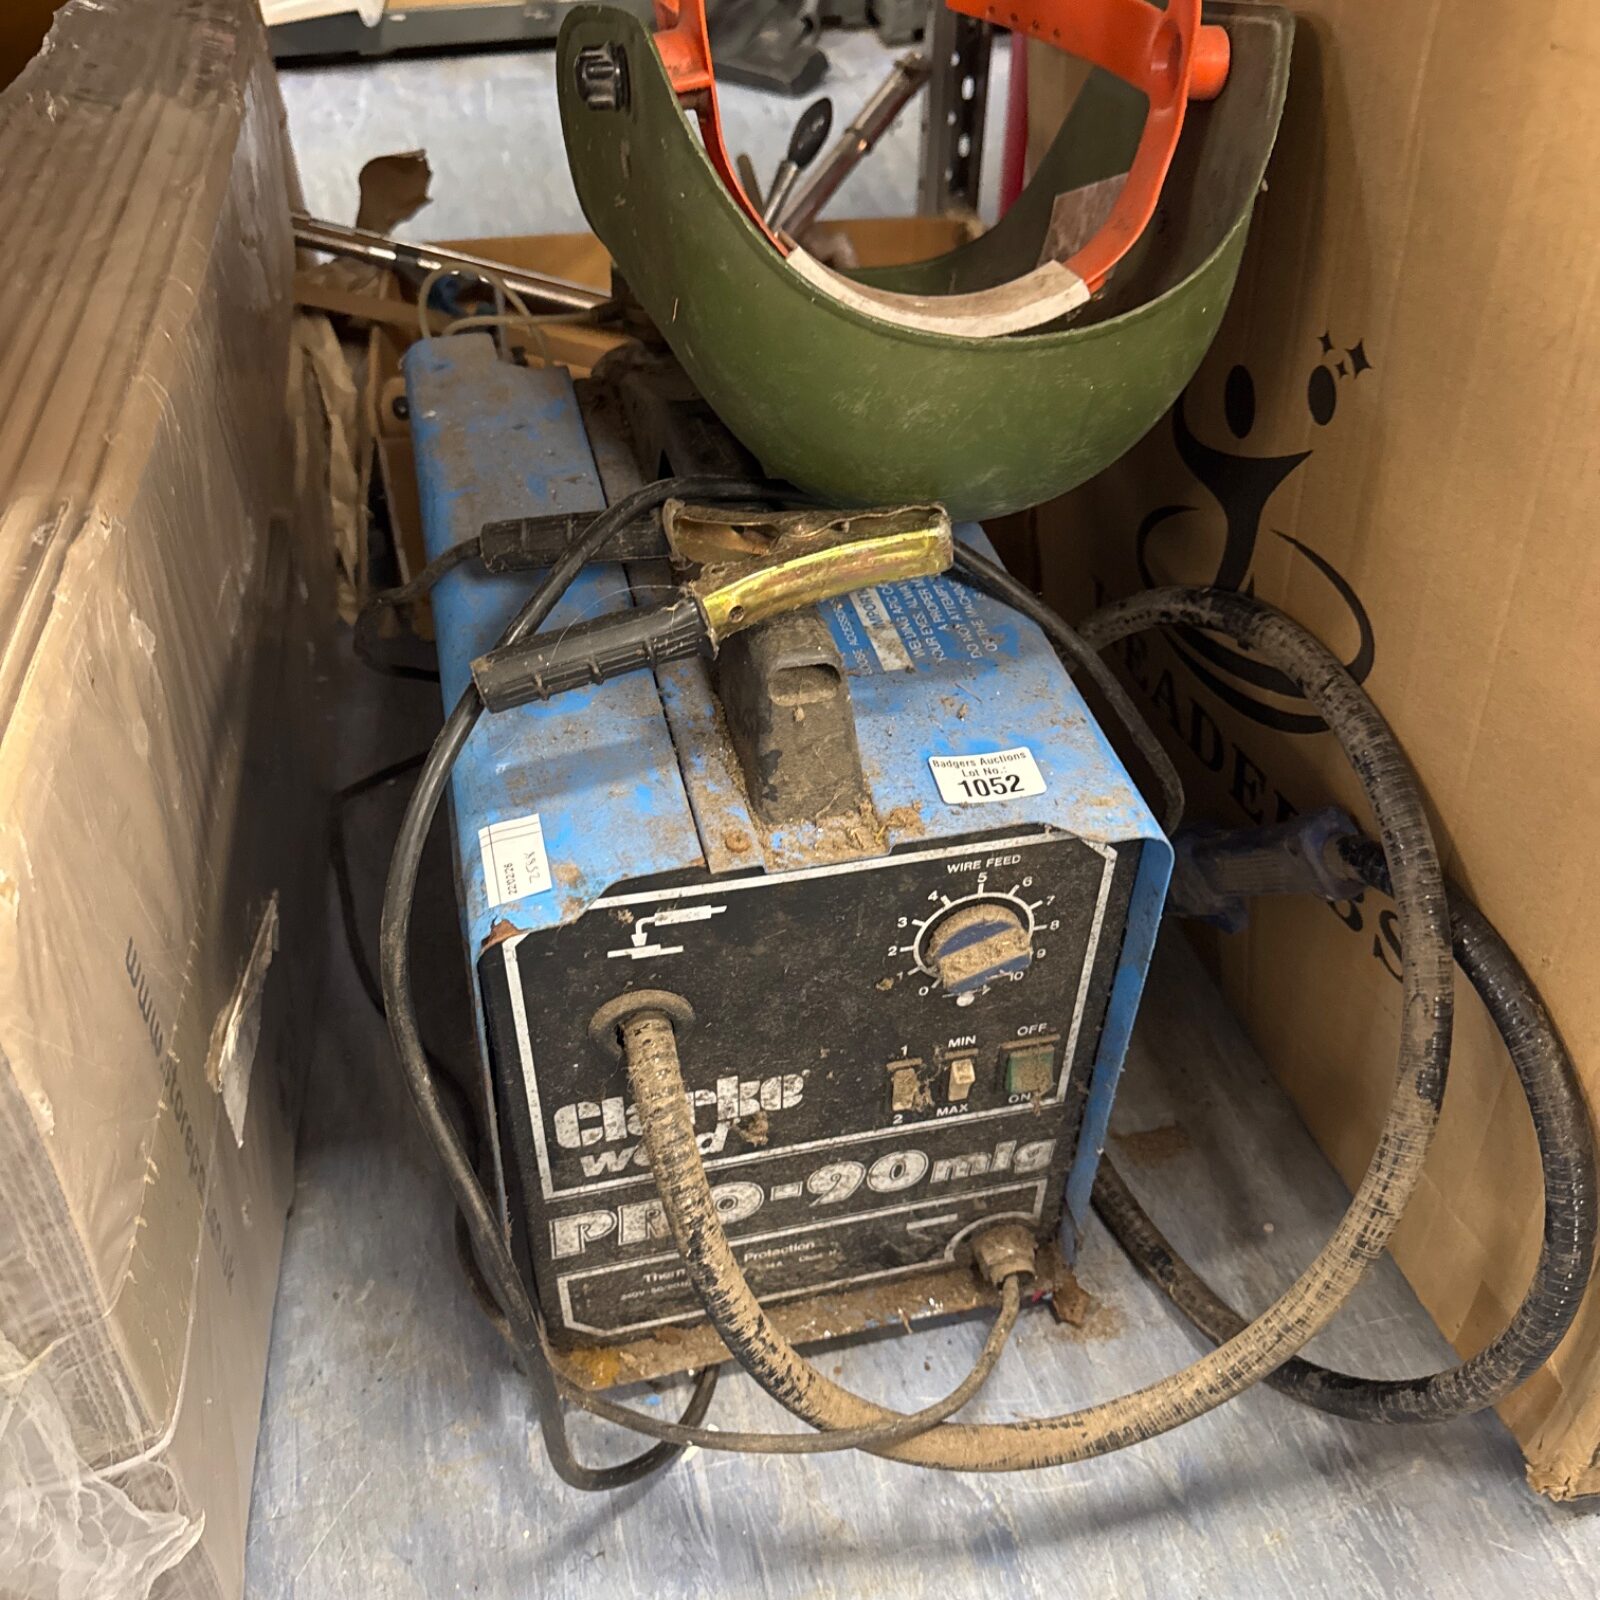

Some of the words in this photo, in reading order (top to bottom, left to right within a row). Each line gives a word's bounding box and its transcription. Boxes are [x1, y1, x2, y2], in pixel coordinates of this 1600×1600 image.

[932, 758, 977, 769] Badgers
[980, 751, 1027, 766] Auctions
[961, 768, 980, 778] Lot
[957, 774, 1025, 798] 1052
[946, 858, 982, 873] WIRE
[985, 854, 1022, 869] FEED
[977, 872, 988, 883] 5
[1022, 876, 1033, 887] 6
[927, 890, 938, 901] 4
[1046, 895, 1056, 906] 7
[897, 916, 908, 928] 3
[1049, 920, 1060, 931] 8
[887, 945, 898, 957] 2
[1036, 948, 1047, 959] 9
[1008, 971, 1024, 982] 10
[1017, 1022, 1048, 1037] OFF
[947, 1034, 977, 1049] MIN
[900, 1045, 908, 1057] 1
[1008, 1092, 1031, 1104] ON
[936, 1102, 969, 1117] MAX
[892, 1113, 904, 1125] 2
[743, 1239, 816, 1263] Protection
